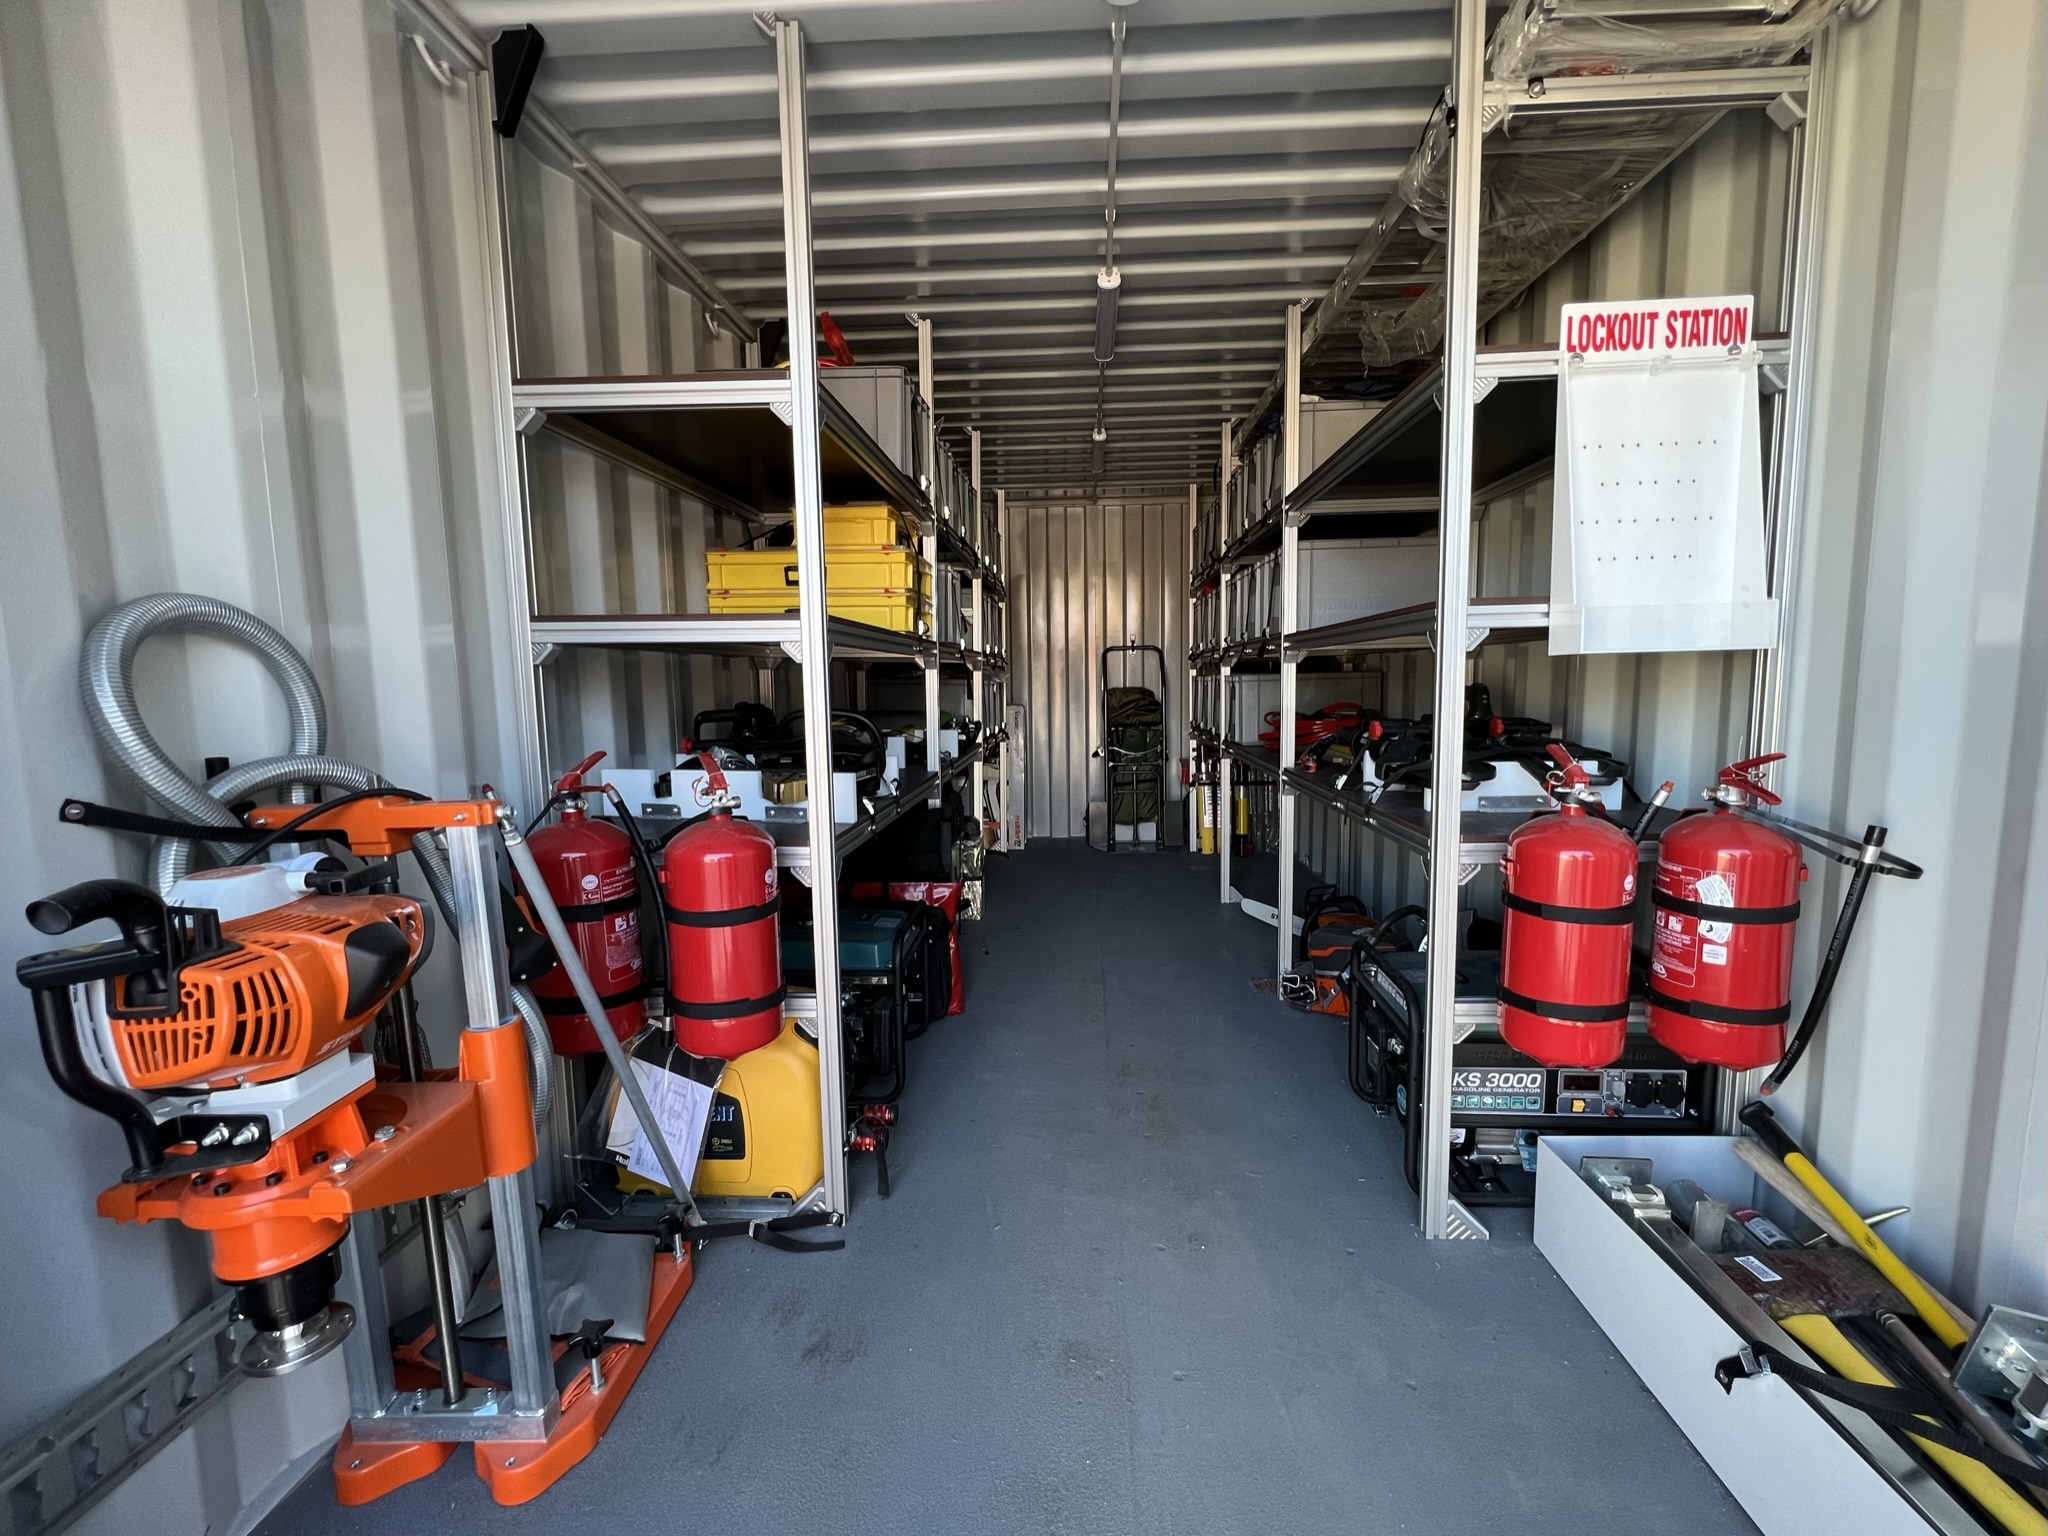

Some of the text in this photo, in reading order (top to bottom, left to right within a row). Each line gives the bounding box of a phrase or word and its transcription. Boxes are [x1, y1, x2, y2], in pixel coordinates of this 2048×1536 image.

[1566, 307, 1748, 353] LOCKOUT STATION
[1452, 1072, 1542, 1088] KS 3000
